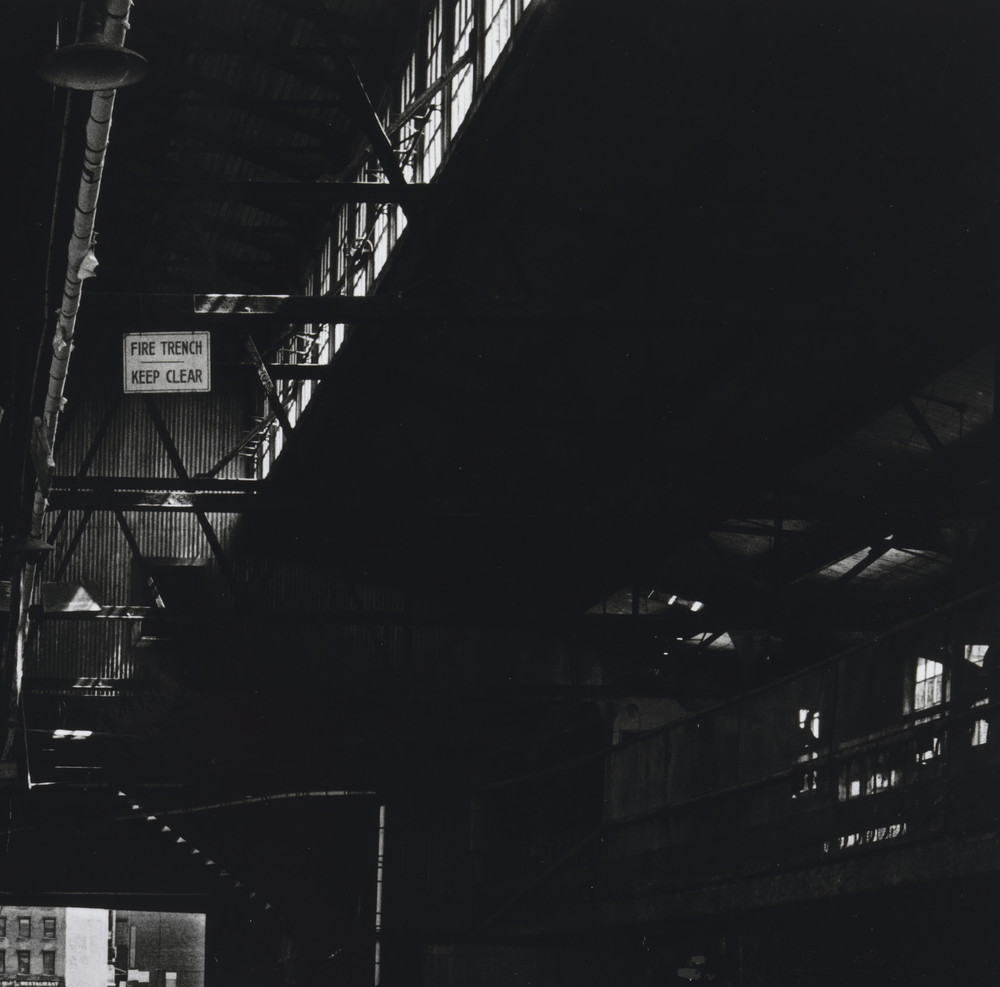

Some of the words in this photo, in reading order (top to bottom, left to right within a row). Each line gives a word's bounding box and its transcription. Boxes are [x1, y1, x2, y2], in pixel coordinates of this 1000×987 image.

[130, 341, 156, 356] FIRE
[160, 340, 203, 356] TRENCH
[131, 369, 160, 384] KEEP
[165, 368, 203, 384] CLEAR
[20, 980, 59, 987] RESTAURANT
